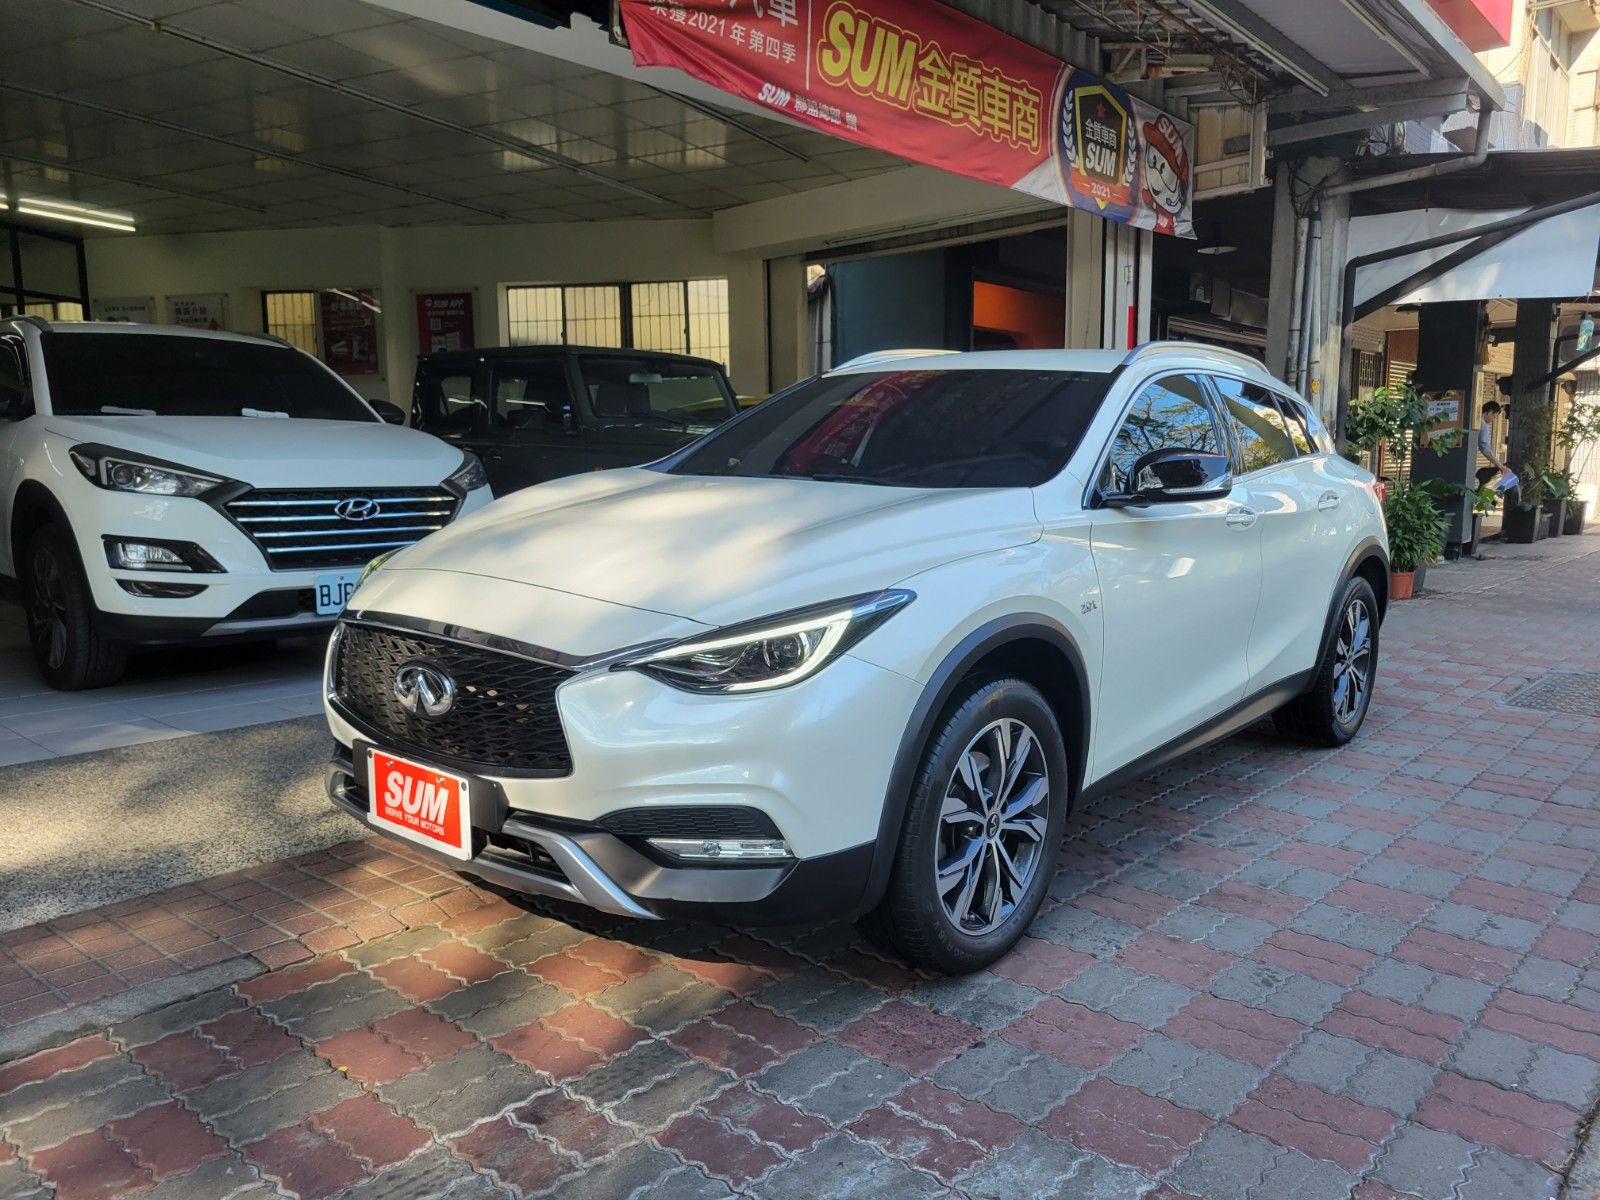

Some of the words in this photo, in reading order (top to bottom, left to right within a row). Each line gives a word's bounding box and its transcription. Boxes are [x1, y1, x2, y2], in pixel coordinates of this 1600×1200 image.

[820, 8, 918, 102] SUM
[916, 48, 1041, 148] 金質車商
[757, 82, 791, 108] SUM
[1085, 117, 1117, 150] 金質車商
[1085, 141, 1117, 178] SUM
[1090, 181, 1111, 199] 2021
[383, 770, 450, 826] SUM
[384, 806, 404, 821] SERVE
[404, 813, 420, 827] YOUR
[419, 819, 445, 837] MOTORS
